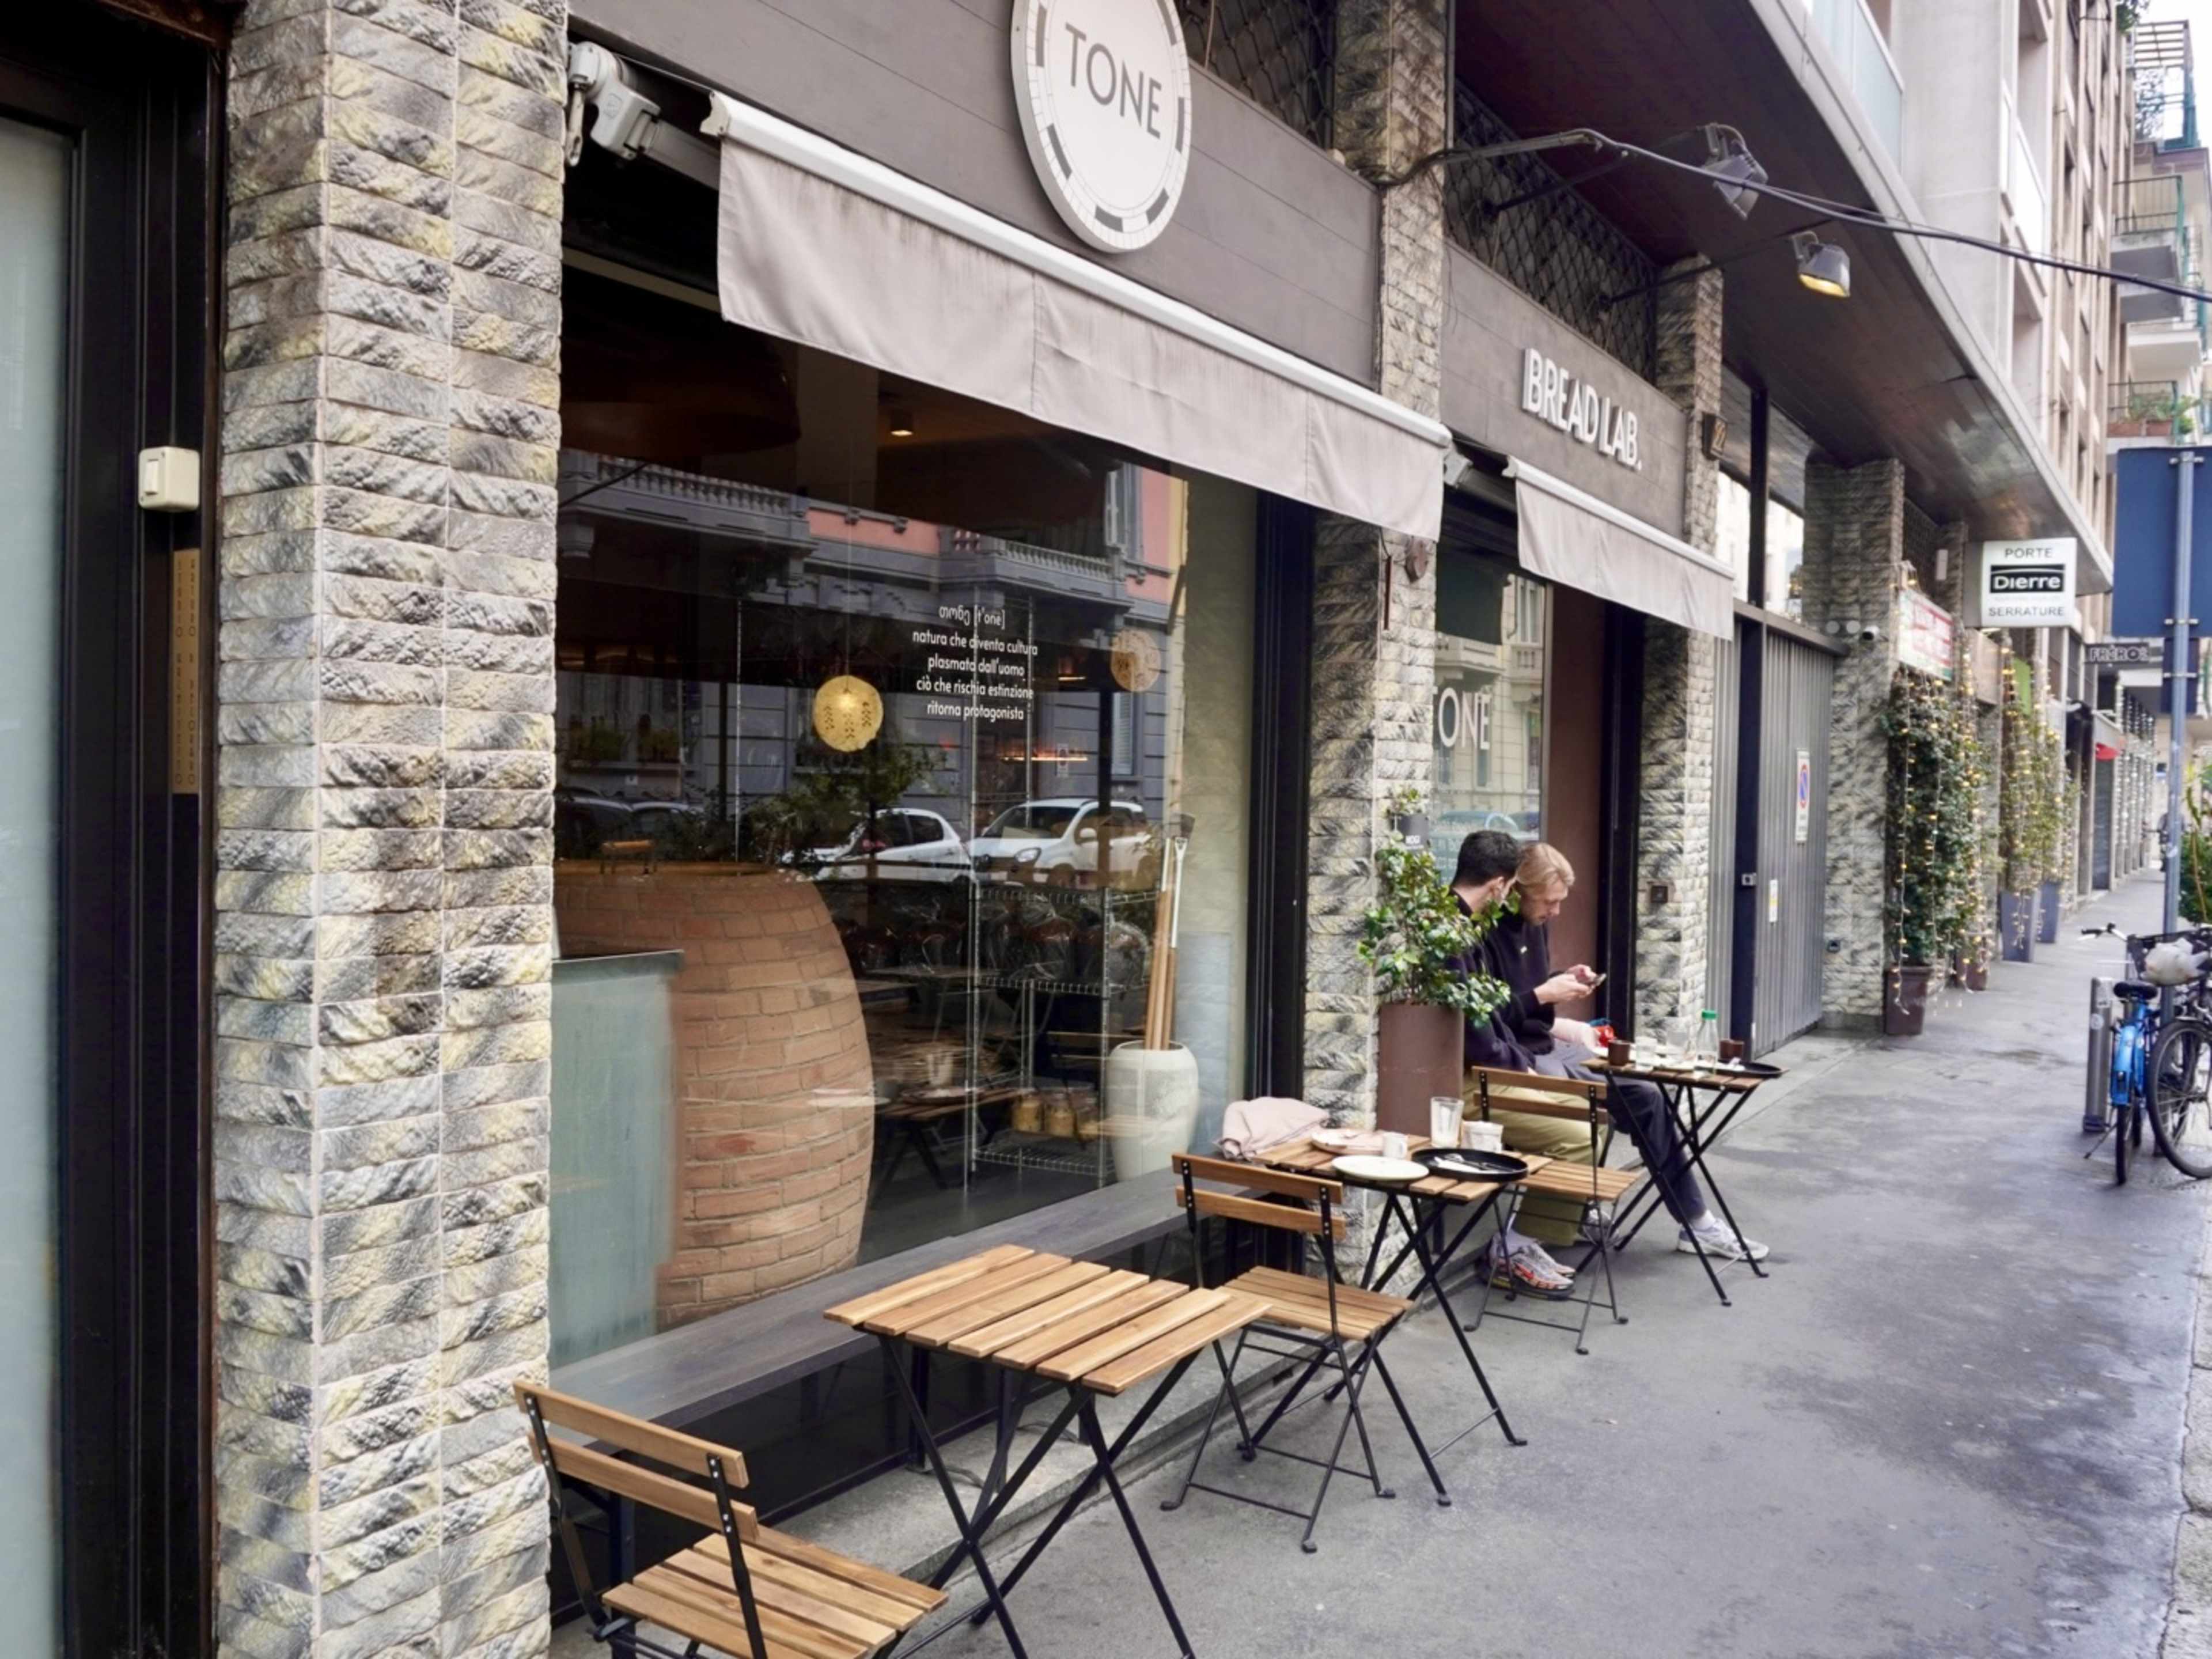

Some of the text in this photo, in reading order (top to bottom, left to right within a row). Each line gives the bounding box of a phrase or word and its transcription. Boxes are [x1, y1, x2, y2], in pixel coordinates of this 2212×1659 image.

[1065, 22, 1161, 139] TONE
[1522, 348, 1642, 471] BREAD LAB.
[2005, 548, 2052, 558] PORTE
[1994, 575, 2061, 590] Dierre
[1989, 607, 2065, 617] SERRATURE
[912, 630, 1038, 656] natura che diventa cultura
[927, 653, 975, 672] plasmata
[916, 675, 1033, 699] ciò che rischia estinzione
[927, 700, 1024, 722] ritorna protagonista
[1433, 686, 1492, 750] ONE
